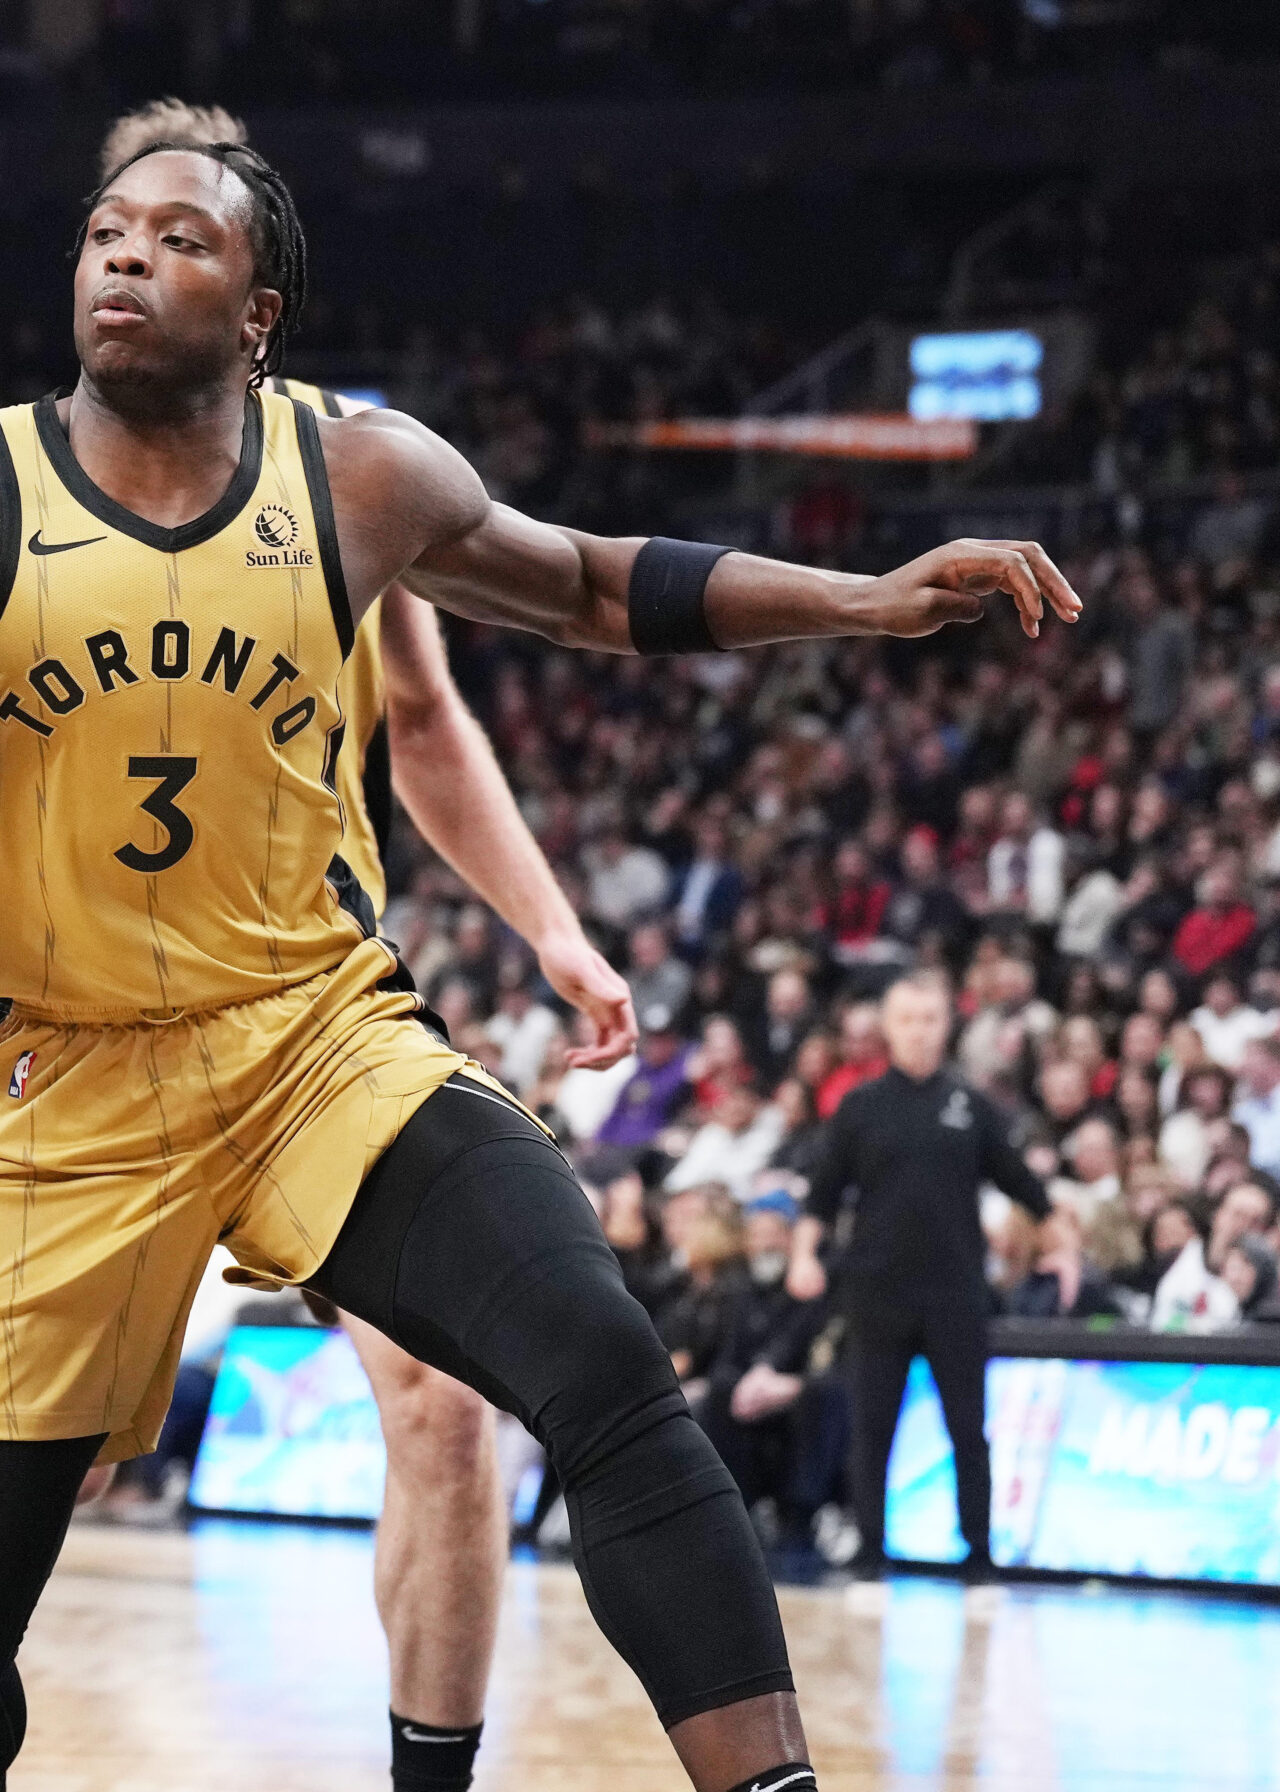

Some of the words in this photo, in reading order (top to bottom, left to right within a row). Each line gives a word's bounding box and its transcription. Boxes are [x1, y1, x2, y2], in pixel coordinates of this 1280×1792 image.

[246, 551, 280, 567] Sun
[282, 549, 314, 565] Life
[113, 756, 198, 873] 3
[1089, 1402, 1271, 1486] MADE
